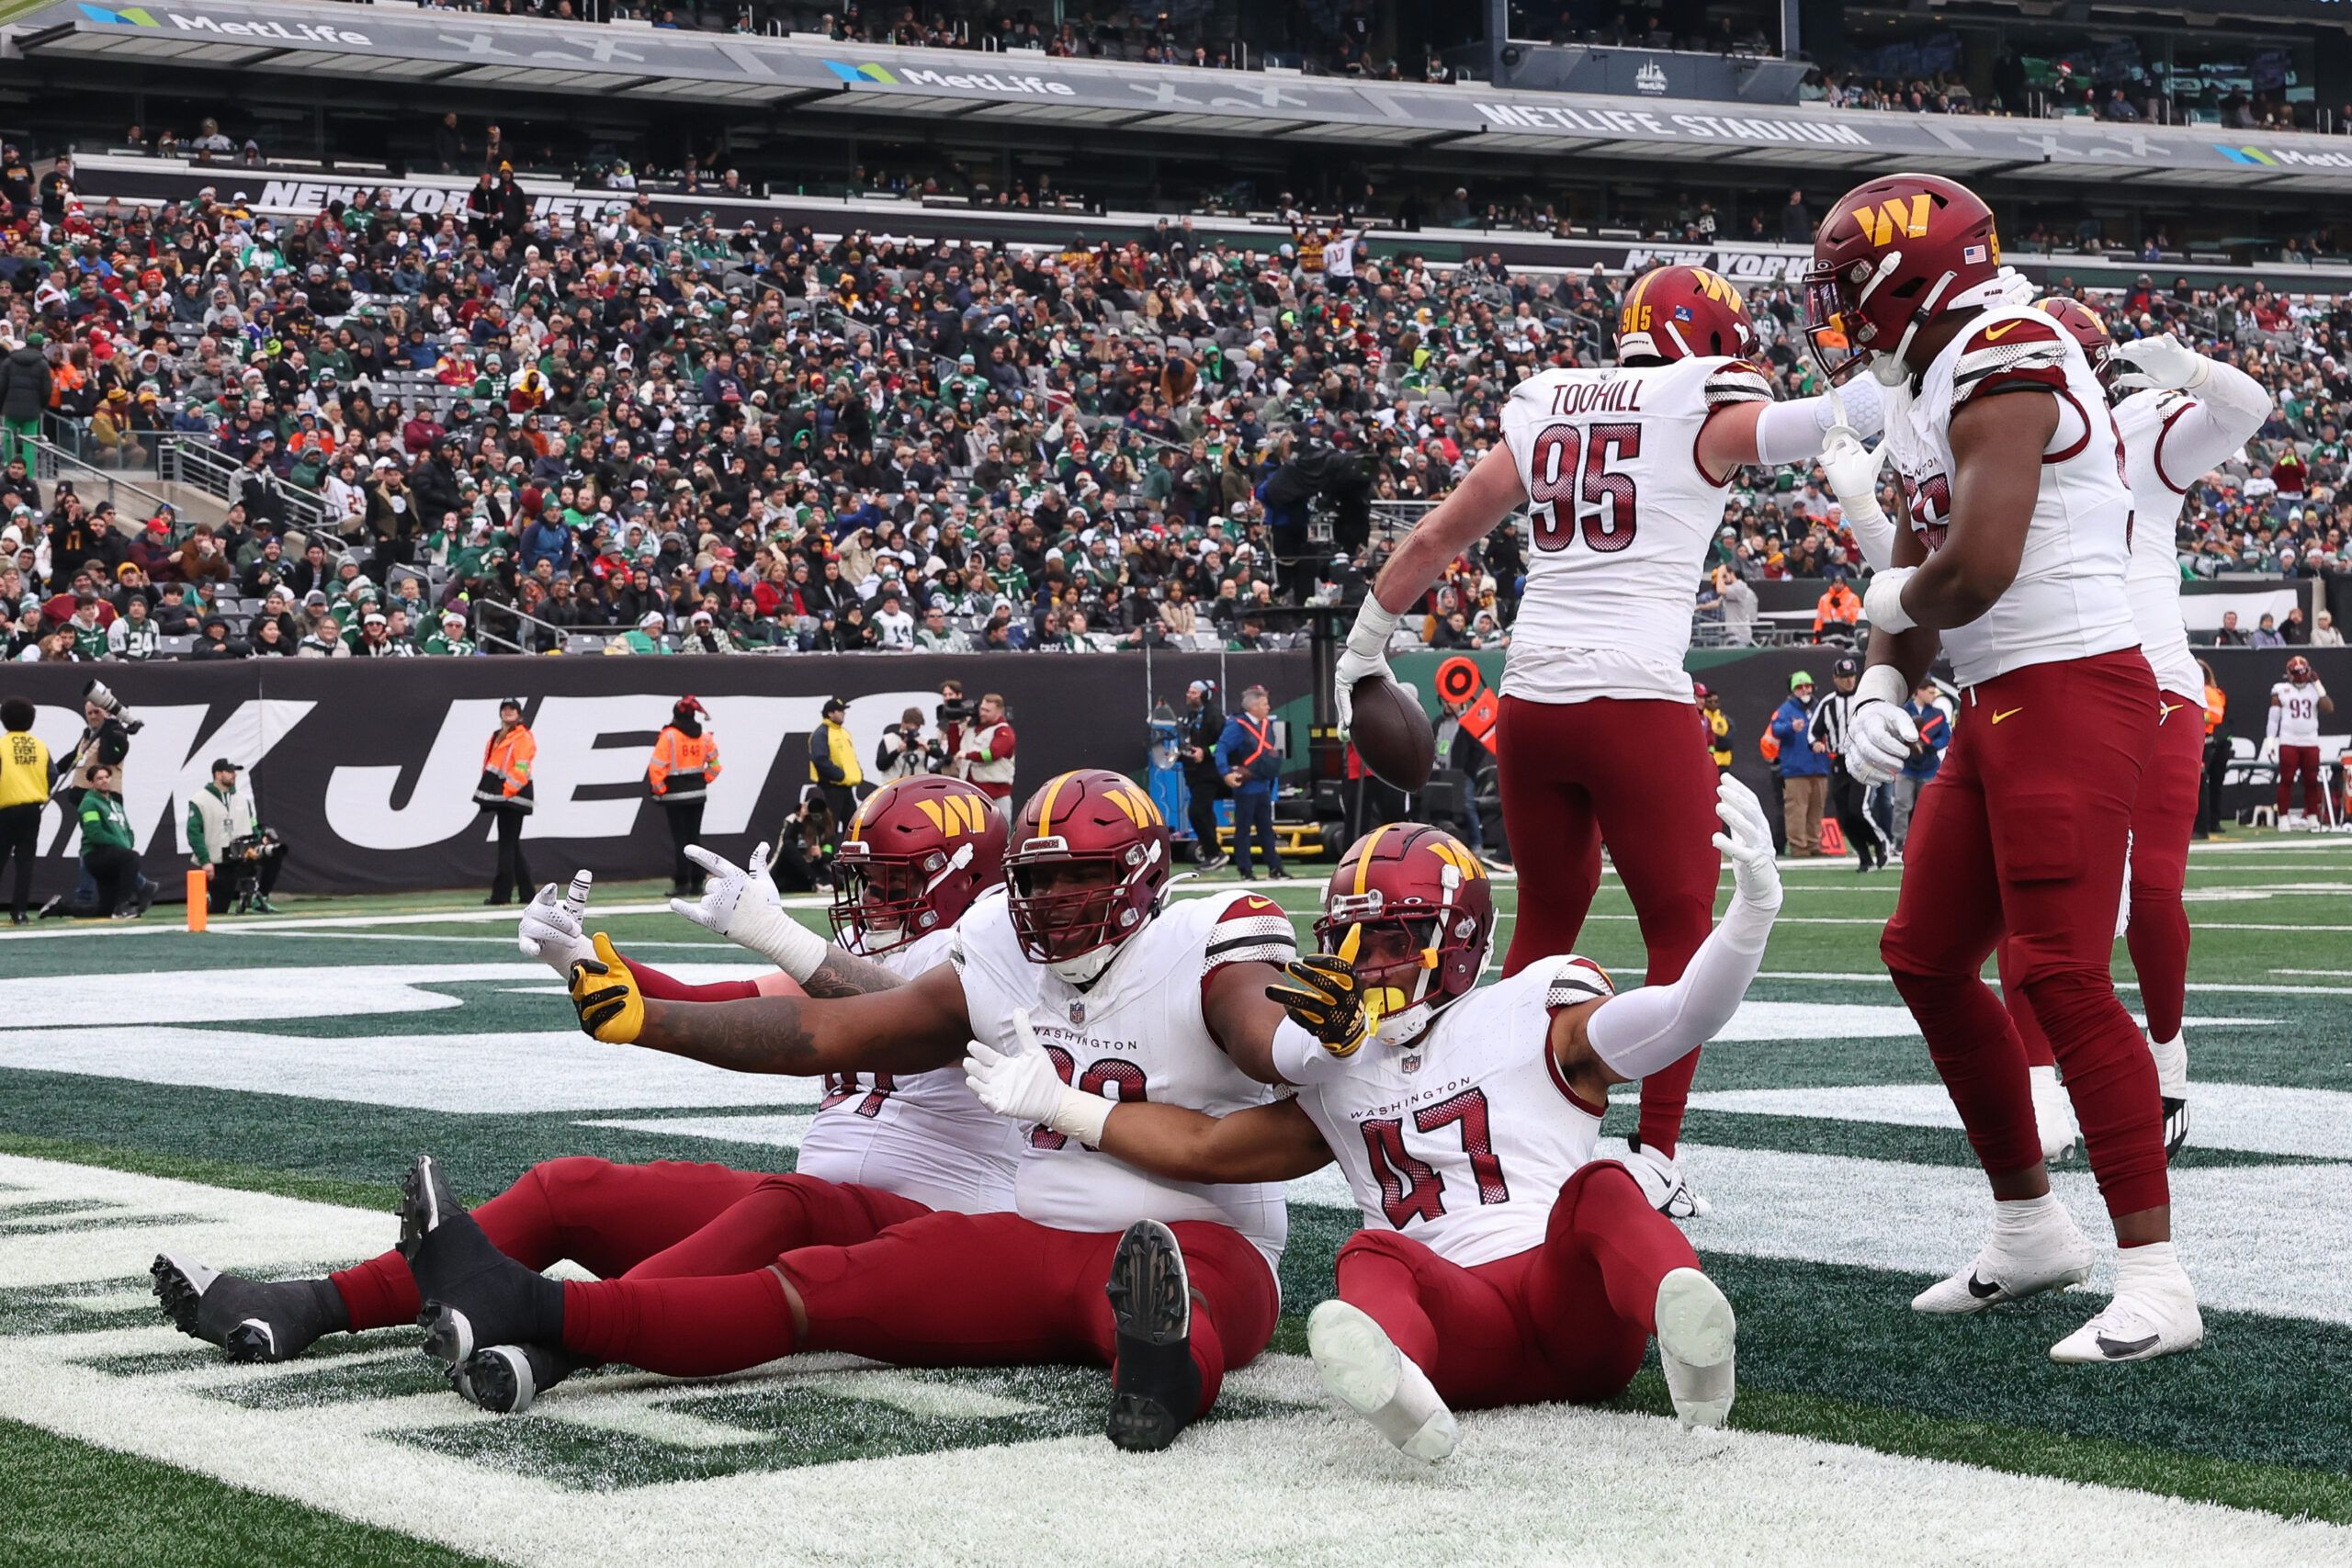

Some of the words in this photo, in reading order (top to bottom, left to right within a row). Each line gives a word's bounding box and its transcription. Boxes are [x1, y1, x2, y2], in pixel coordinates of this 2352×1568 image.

[168, 14, 372, 46] MetLife
[899, 67, 1076, 96] MetLife
[1473, 102, 1677, 135] METLIFE
[1670, 113, 1871, 145] STADIUM
[390, 186, 469, 216] YOR
[1716, 254, 1812, 277] YORK
[1623, 305, 1652, 333] 95
[1551, 379, 1644, 414] TOOHILL
[1531, 423, 1642, 552] 95
[2290, 698, 2312, 719] 93
[12, 736, 35, 745] CSC
[14, 745, 36, 755] EVENT
[15, 755, 38, 765] STAFF
[1032, 1027, 1137, 1050] WASHINGTON
[1350, 1076, 1471, 1120] WASHINGTON
[1359, 1086, 1510, 1231] 47
